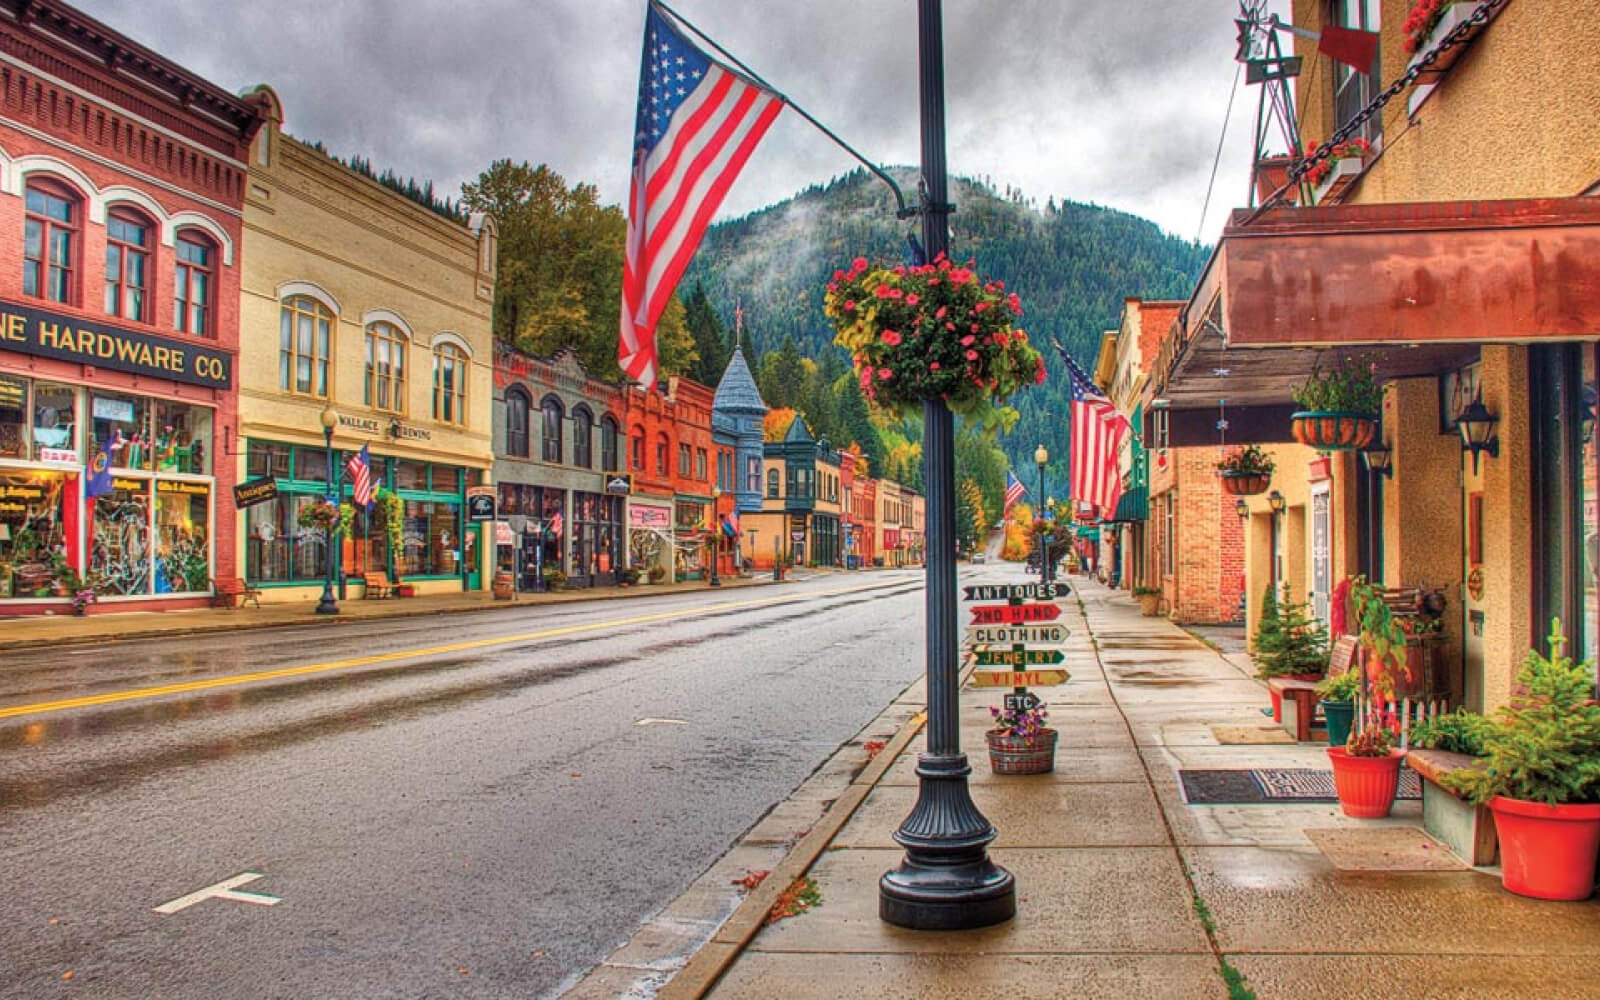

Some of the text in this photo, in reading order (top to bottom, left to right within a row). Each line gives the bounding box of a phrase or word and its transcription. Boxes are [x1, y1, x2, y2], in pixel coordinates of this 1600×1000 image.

[39, 320, 185, 373] HARDWARE
[195, 355, 227, 380] CO.
[338, 414, 433, 440] WALLACE REWING
[973, 584, 1057, 600] ANTIQUES
[976, 605, 1054, 623] 2ND HAND
[976, 628, 1061, 641] CLOTHING
[984, 651, 1055, 664] JEWELRY
[992, 672, 1044, 686] VINYL
[1006, 696, 1034, 709] ETC
